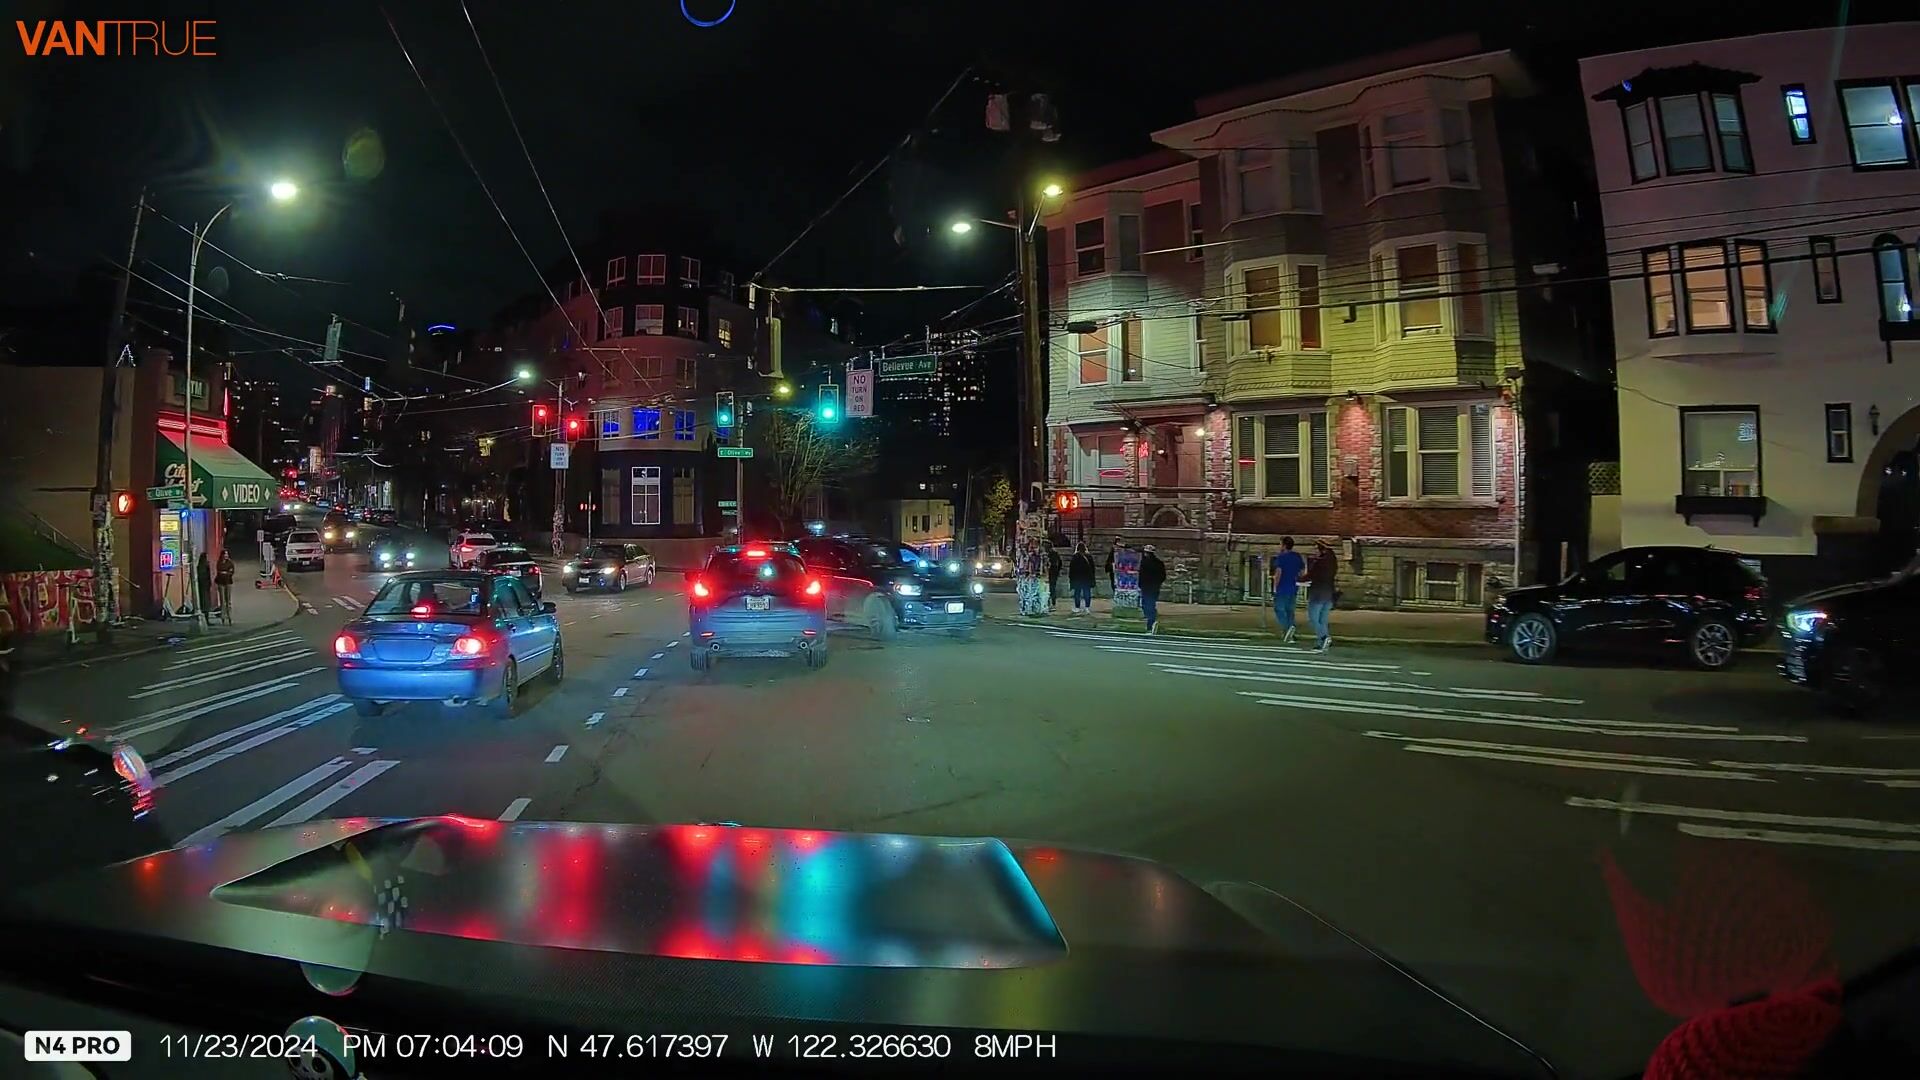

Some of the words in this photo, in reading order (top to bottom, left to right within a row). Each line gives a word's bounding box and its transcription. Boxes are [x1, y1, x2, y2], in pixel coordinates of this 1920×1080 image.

[882, 361, 914, 372] Bellevue
[853, 375, 866, 385] NO
[852, 386, 867, 394] TURN
[854, 395, 864, 403] ON
[853, 403, 865, 412] RED
[232, 483, 260, 503] VIDEO
